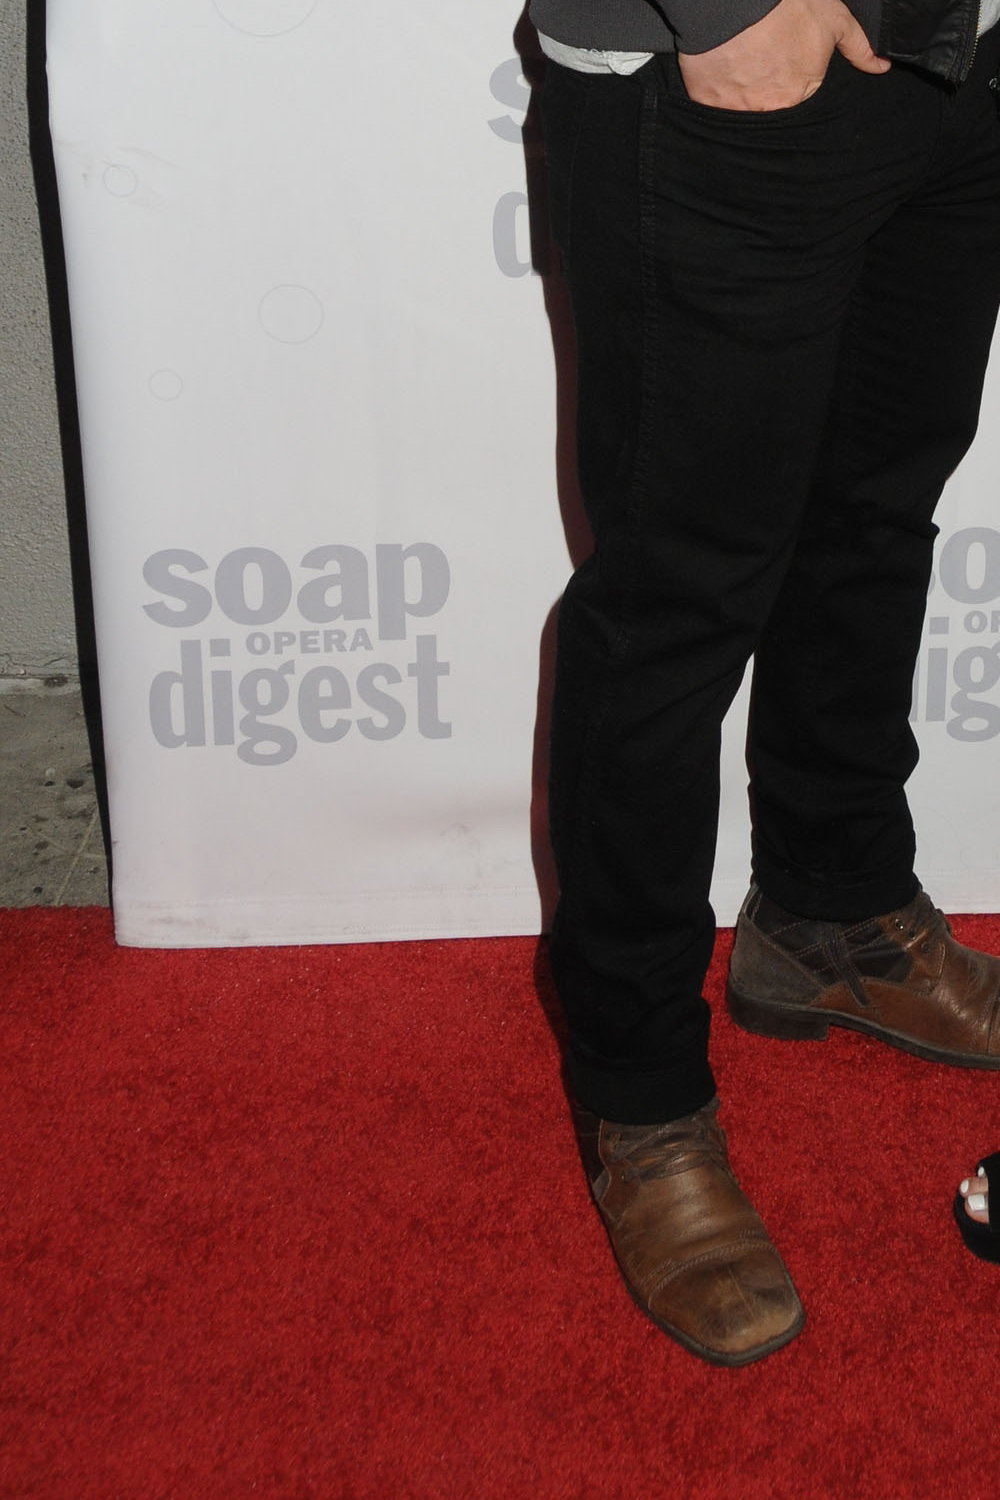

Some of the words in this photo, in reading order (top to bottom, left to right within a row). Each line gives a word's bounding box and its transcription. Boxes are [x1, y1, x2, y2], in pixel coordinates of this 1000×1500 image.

[142, 542, 451, 640] soap
[246, 628, 373, 655] OPERA
[149, 634, 452, 766] digest
